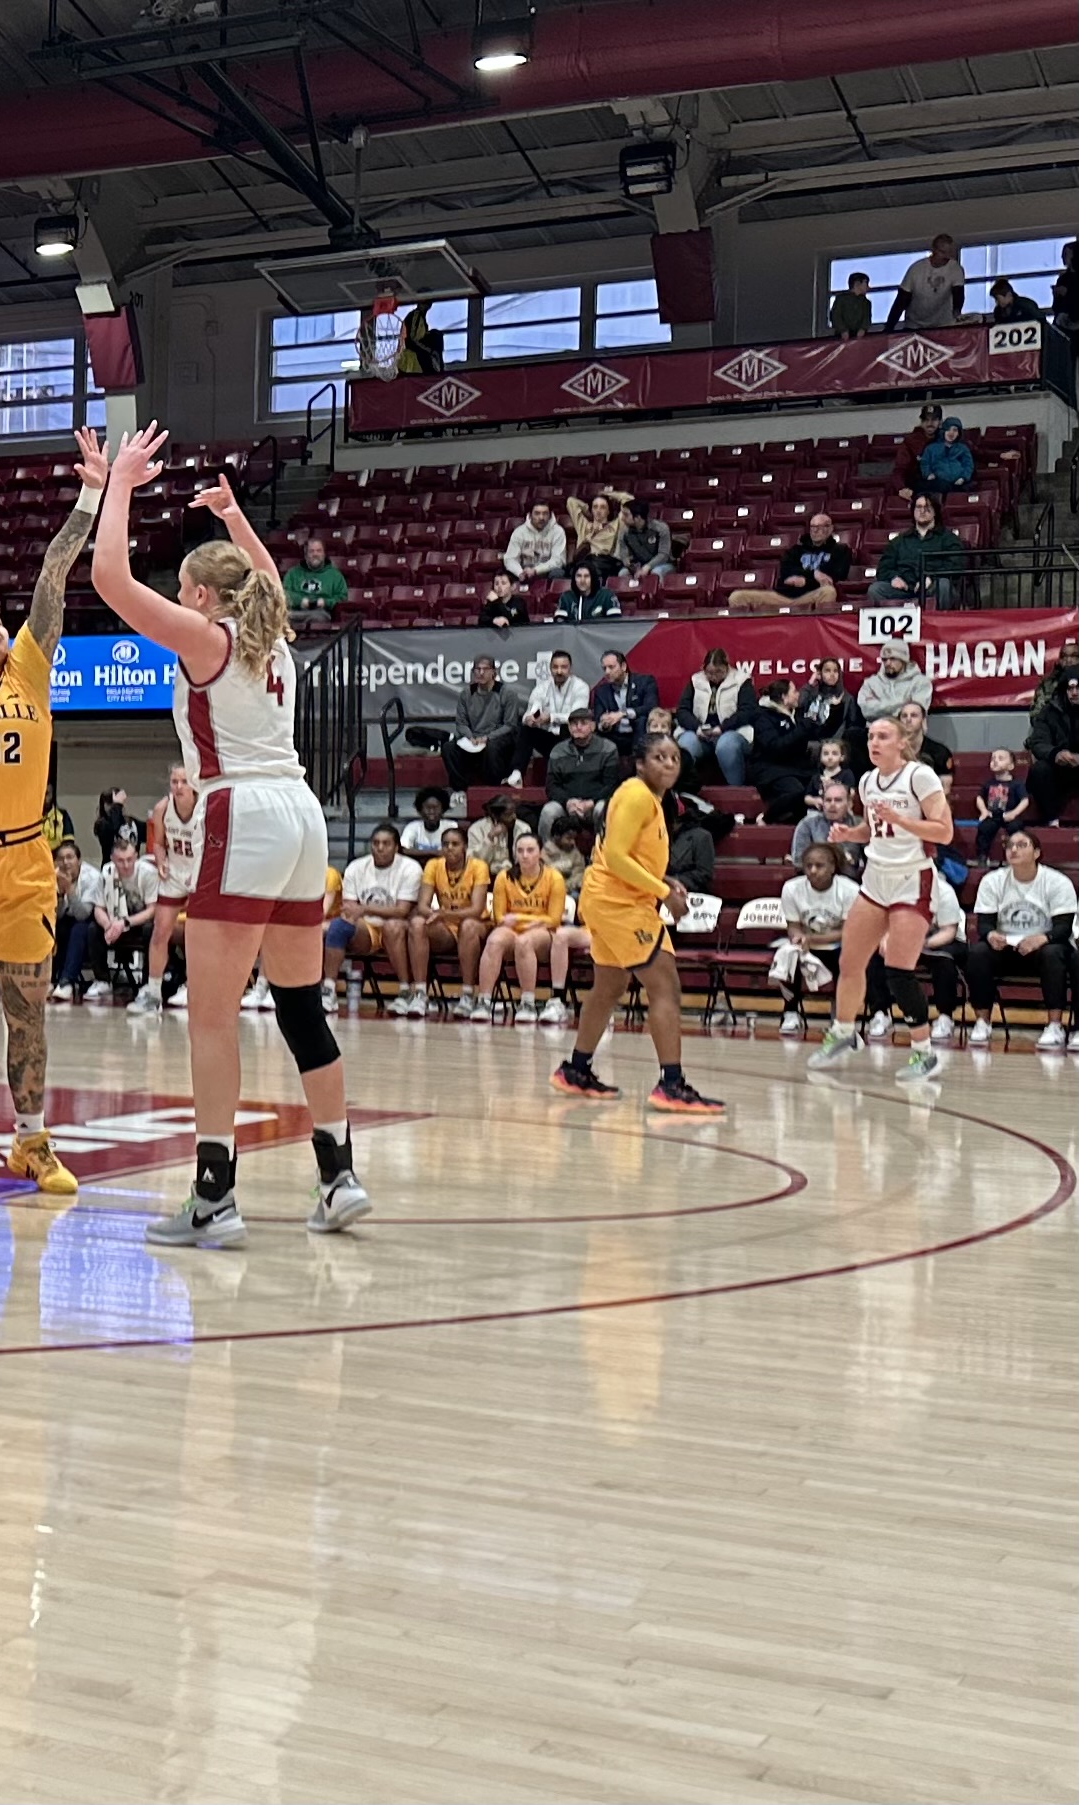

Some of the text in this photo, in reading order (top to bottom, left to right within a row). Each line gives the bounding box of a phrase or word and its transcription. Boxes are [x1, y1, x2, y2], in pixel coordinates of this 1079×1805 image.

[994, 328, 1038, 349] 202
[869, 615, 913, 636] 102
[736, 657, 863, 675] WELCOE
[925, 640, 1046, 679] HAGAN
[49, 667, 82, 687] ton
[94, 664, 157, 686] Hilton
